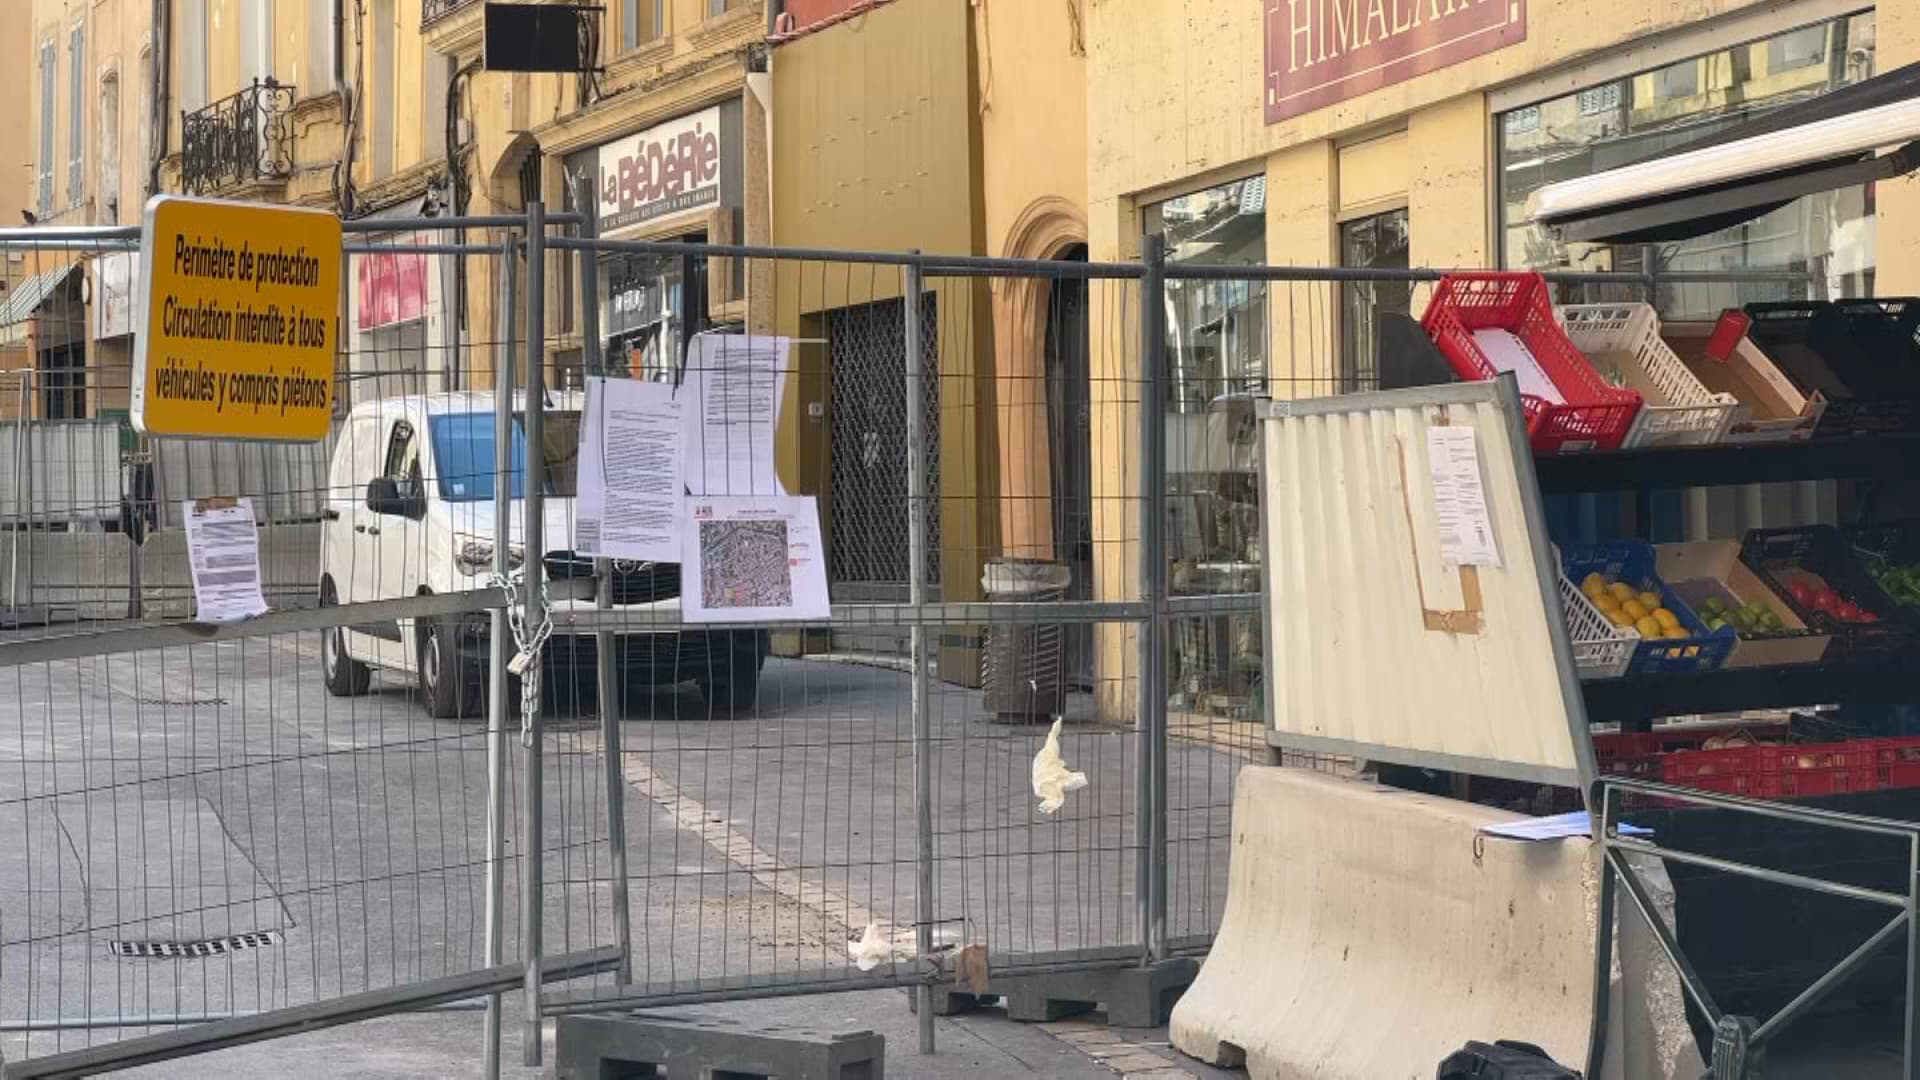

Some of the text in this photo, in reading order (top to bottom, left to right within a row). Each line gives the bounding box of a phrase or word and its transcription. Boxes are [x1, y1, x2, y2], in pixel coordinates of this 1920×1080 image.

[1287, 0, 1488, 73] HIMAL
[601, 166, 617, 205] La
[238, 240, 254, 281] de
[255, 246, 319, 292] protection
[163, 294, 326, 349] Circulation interdite à tous
[155, 356, 327, 416] véhicules y compris piétons
